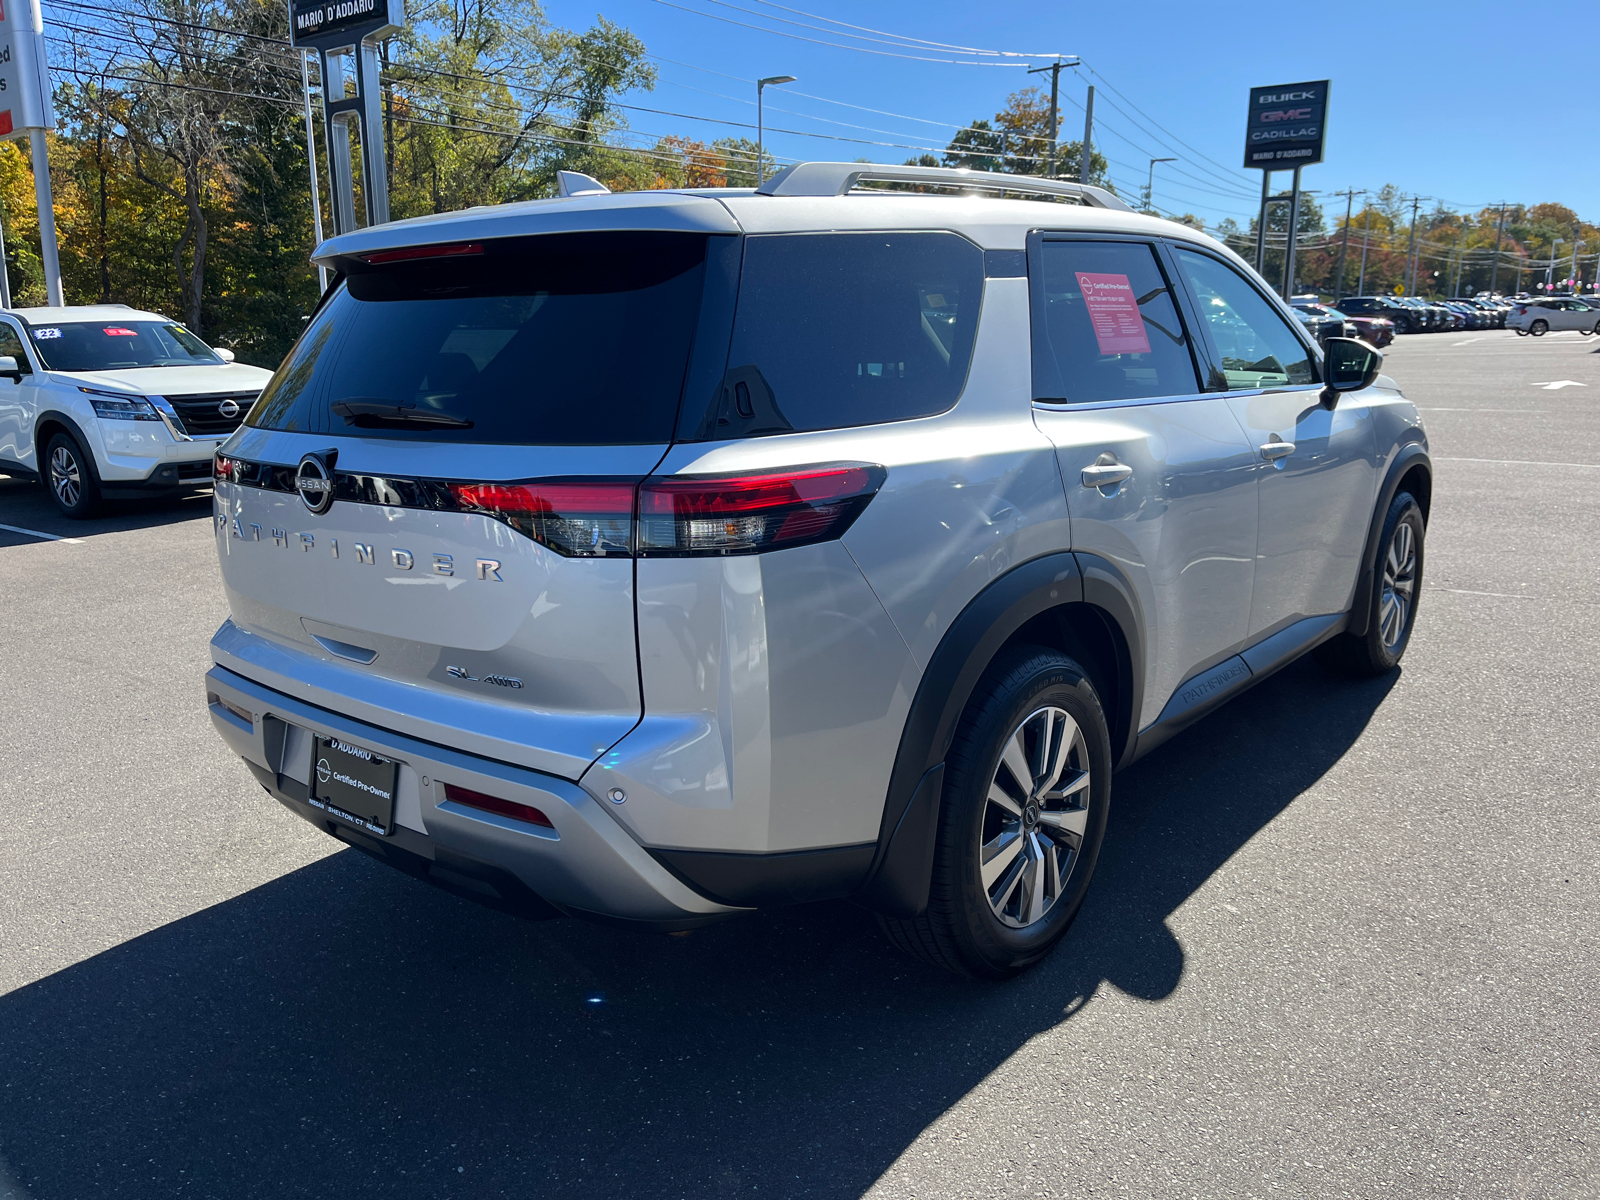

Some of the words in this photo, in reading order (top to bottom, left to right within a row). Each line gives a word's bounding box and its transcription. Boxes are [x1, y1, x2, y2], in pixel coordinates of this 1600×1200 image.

[297, 9, 324, 30] MARIO
[327, 0, 375, 22] D'ADDARIO
[1259, 91, 1315, 104] BUICK
[1261, 108, 1312, 122] GMC
[1251, 128, 1317, 140] CADILLAC
[1252, 152, 1274, 160] MARIO
[295, 478, 330, 490] SSAN
[216, 513, 504, 582] PATHFINDER
[445, 665, 480, 682] SL
[483, 674, 524, 689] AWD
[1181, 663, 1247, 704] PATHFINDER
[331, 740, 371, 761] DADDARIO
[333, 771, 357, 787] Certified
[355, 818, 364, 826] CT
